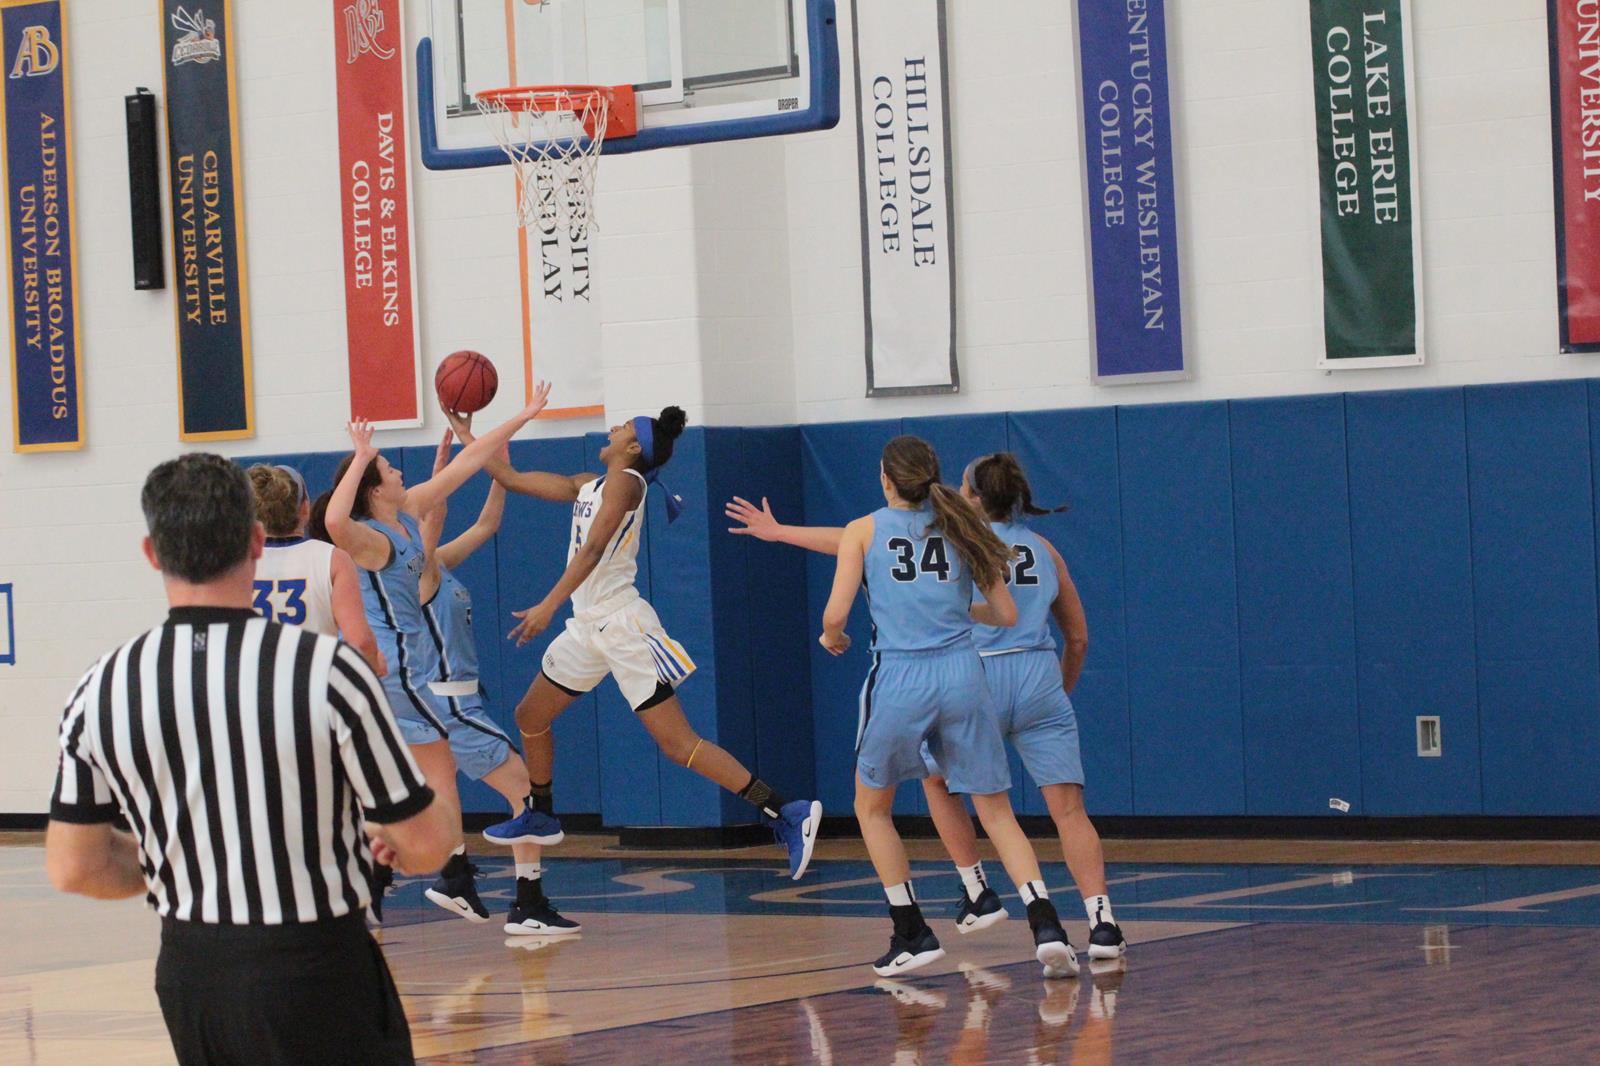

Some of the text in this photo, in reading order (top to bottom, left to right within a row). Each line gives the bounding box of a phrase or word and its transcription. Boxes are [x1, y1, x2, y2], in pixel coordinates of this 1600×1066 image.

[872, 75, 900, 254] COLLEGE
[904, 56, 936, 267] HILLSDALE
[1098, 80, 1125, 228] COLLEGE
[1127, 0, 1164, 331] ENTUCKY WESLEYAN
[1327, 26, 1360, 217] COLLEGE
[1363, 9, 1399, 225] LAKE ERIE
[20, 184, 42, 349] UNIVERSITY
[40, 112, 68, 420] ALDERSON BROADDUS
[178, 154, 202, 326] UNIVERSITY
[203, 150, 227, 326] CEDARVILLE
[351, 160, 373, 289] COLLEGE
[377, 112, 400, 327] DAVIS & ELKINS
[251, 578, 307, 626] 33
[887, 536, 951, 583] 34
